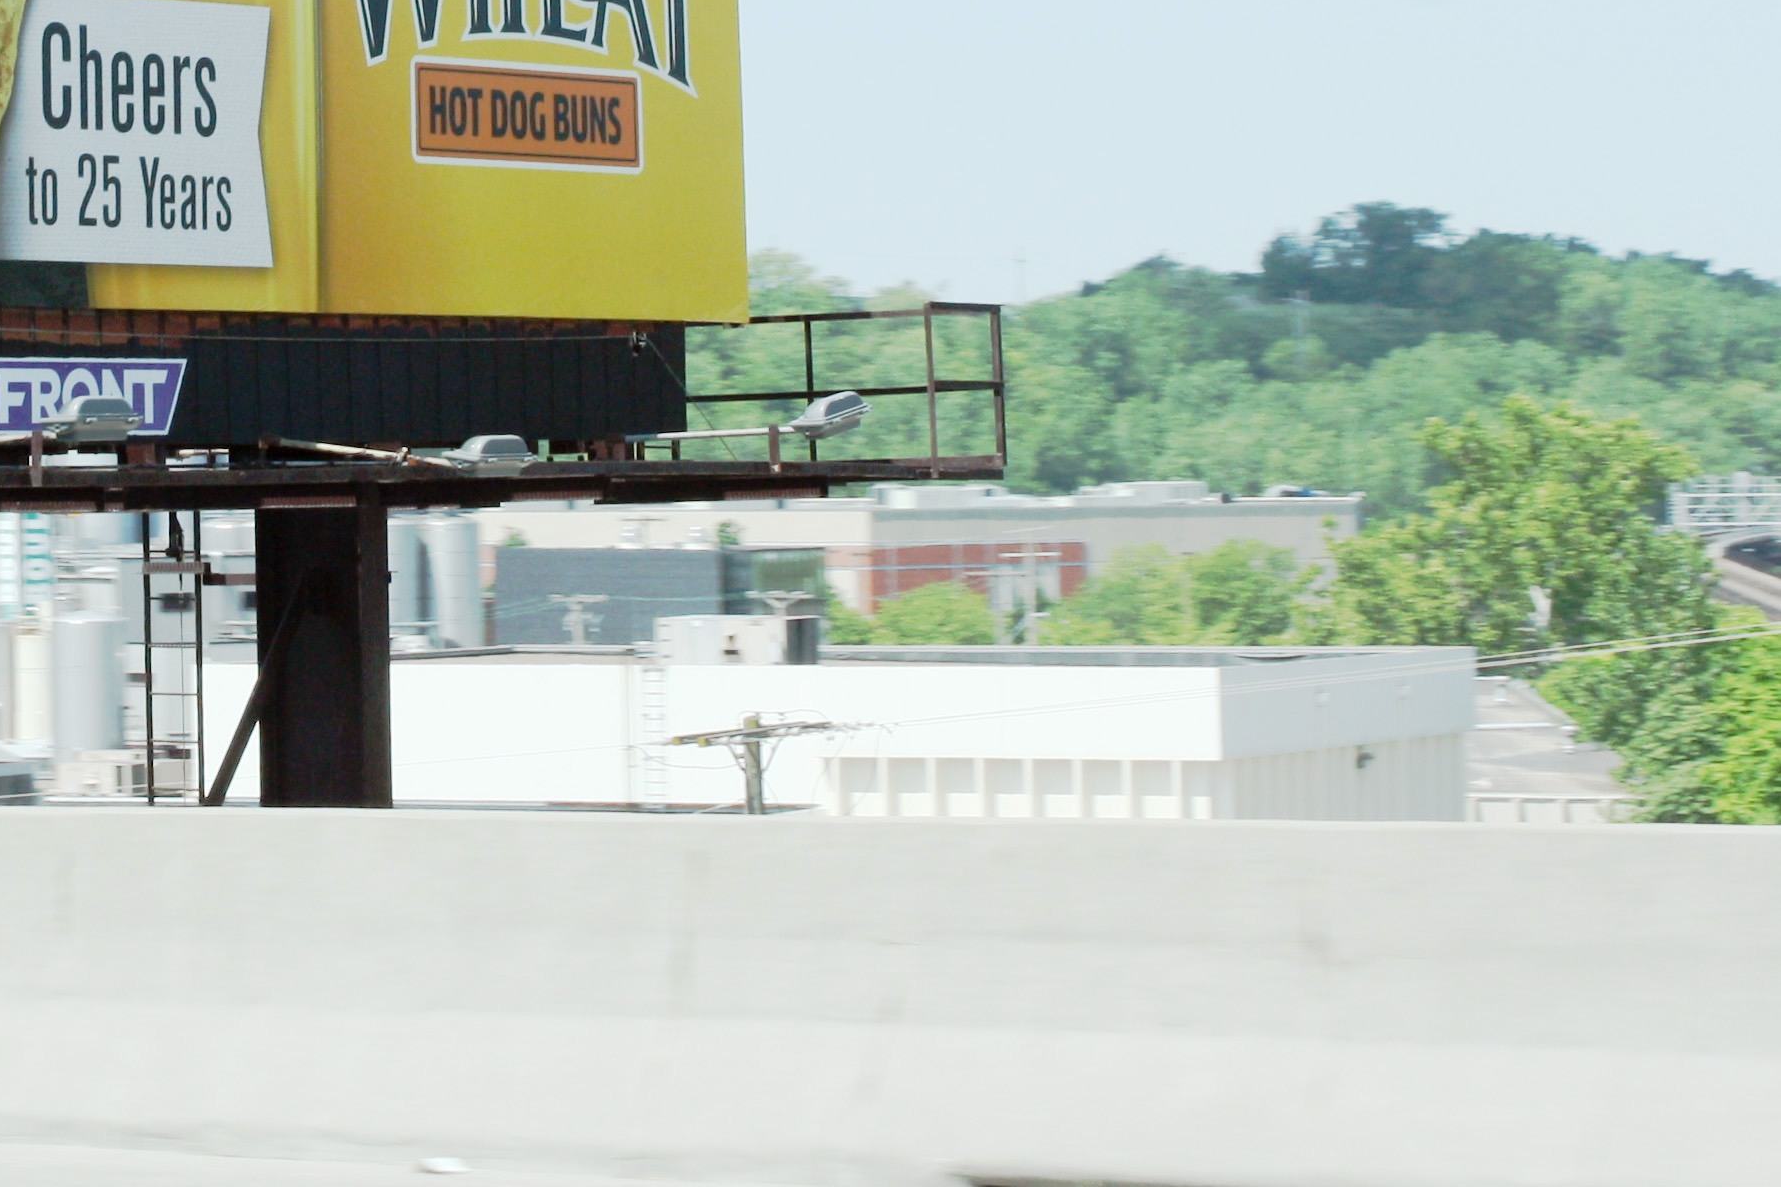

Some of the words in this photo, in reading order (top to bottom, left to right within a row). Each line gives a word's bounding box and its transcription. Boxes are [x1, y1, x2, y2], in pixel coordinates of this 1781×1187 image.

[42, 22, 217, 138] Cheers
[429, 86, 482, 136] HOT
[491, 89, 546, 141] DOG
[553, 93, 622, 145] BUNS
[26, 156, 58, 227] to
[77, 153, 122, 228] 25
[140, 156, 232, 232] Years
